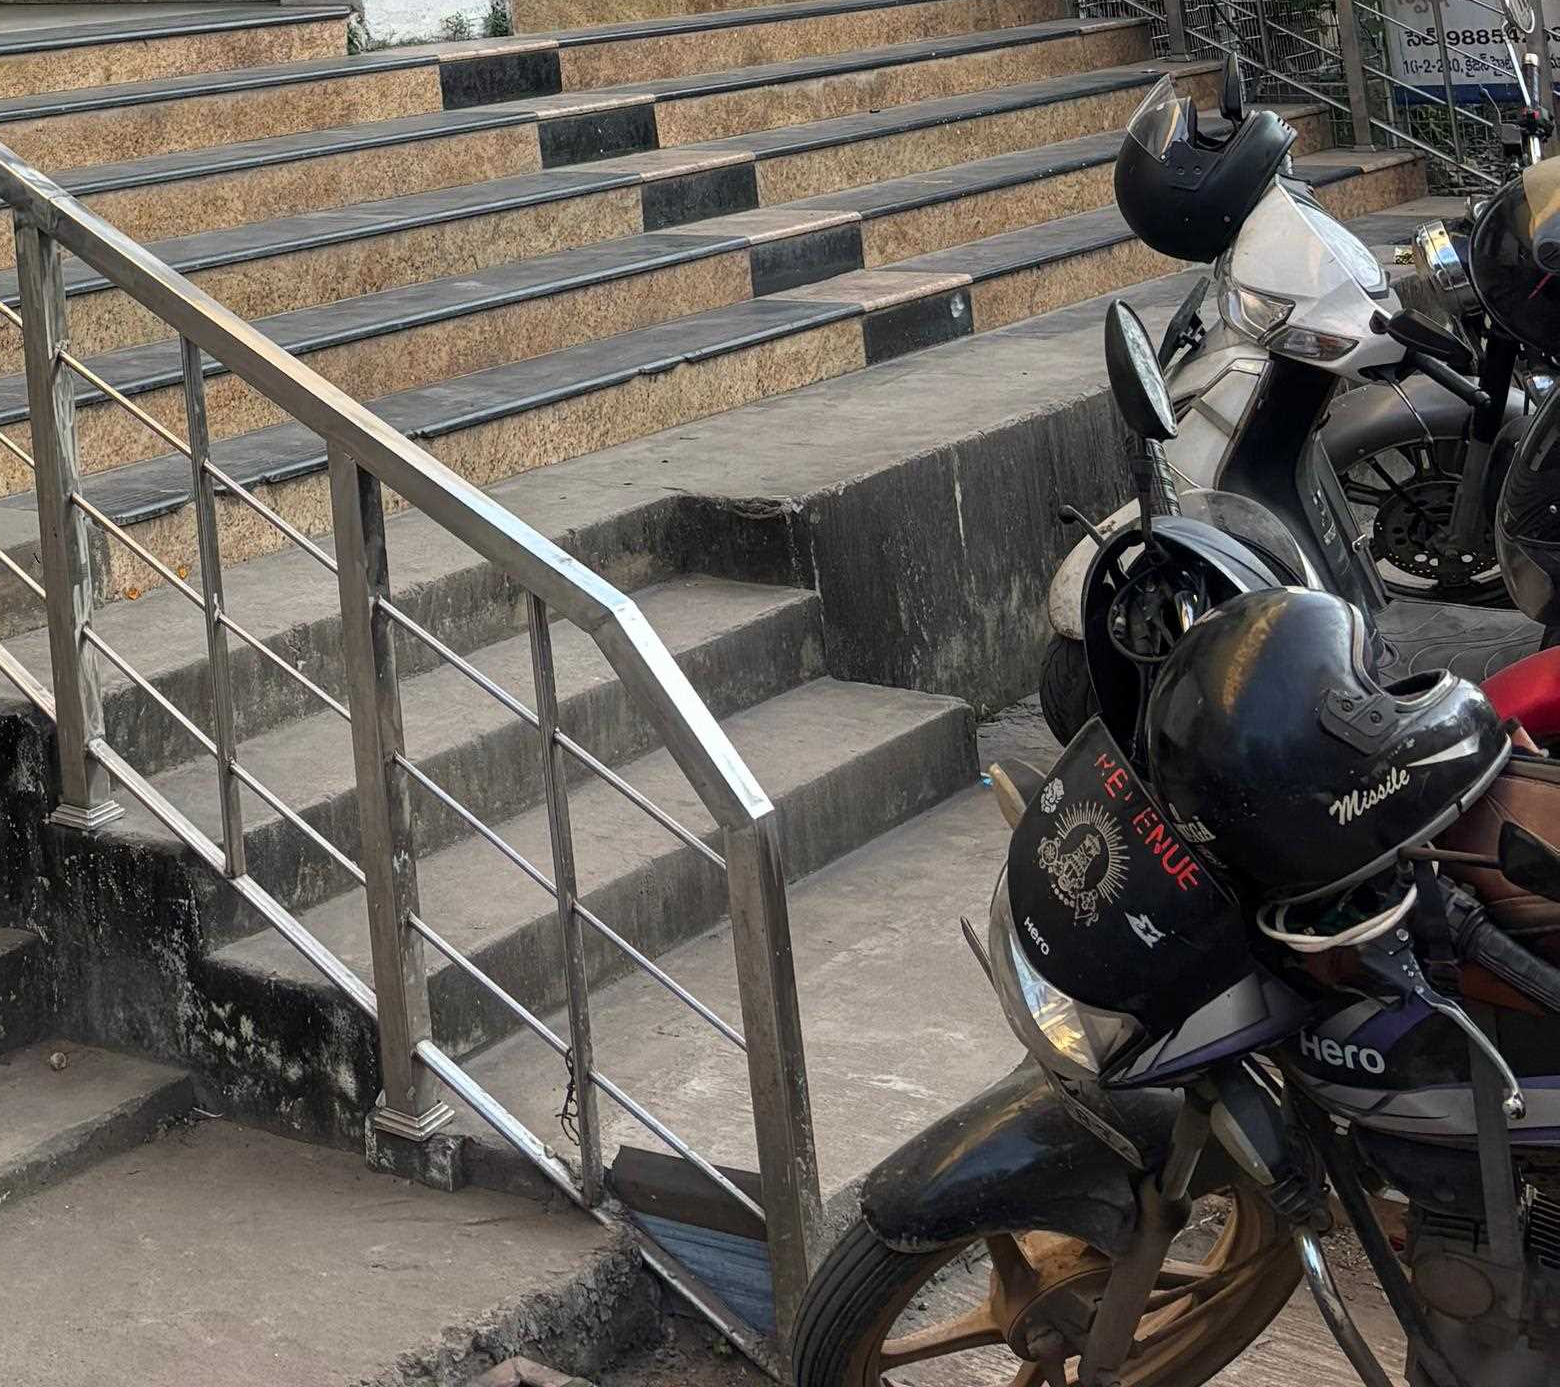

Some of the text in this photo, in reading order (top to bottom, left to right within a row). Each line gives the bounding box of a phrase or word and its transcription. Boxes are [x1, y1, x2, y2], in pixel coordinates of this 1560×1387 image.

[1329, 763, 1411, 826] Missile
[1023, 914, 1051, 958] Hero
[1299, 1028, 1387, 1075] Hero
